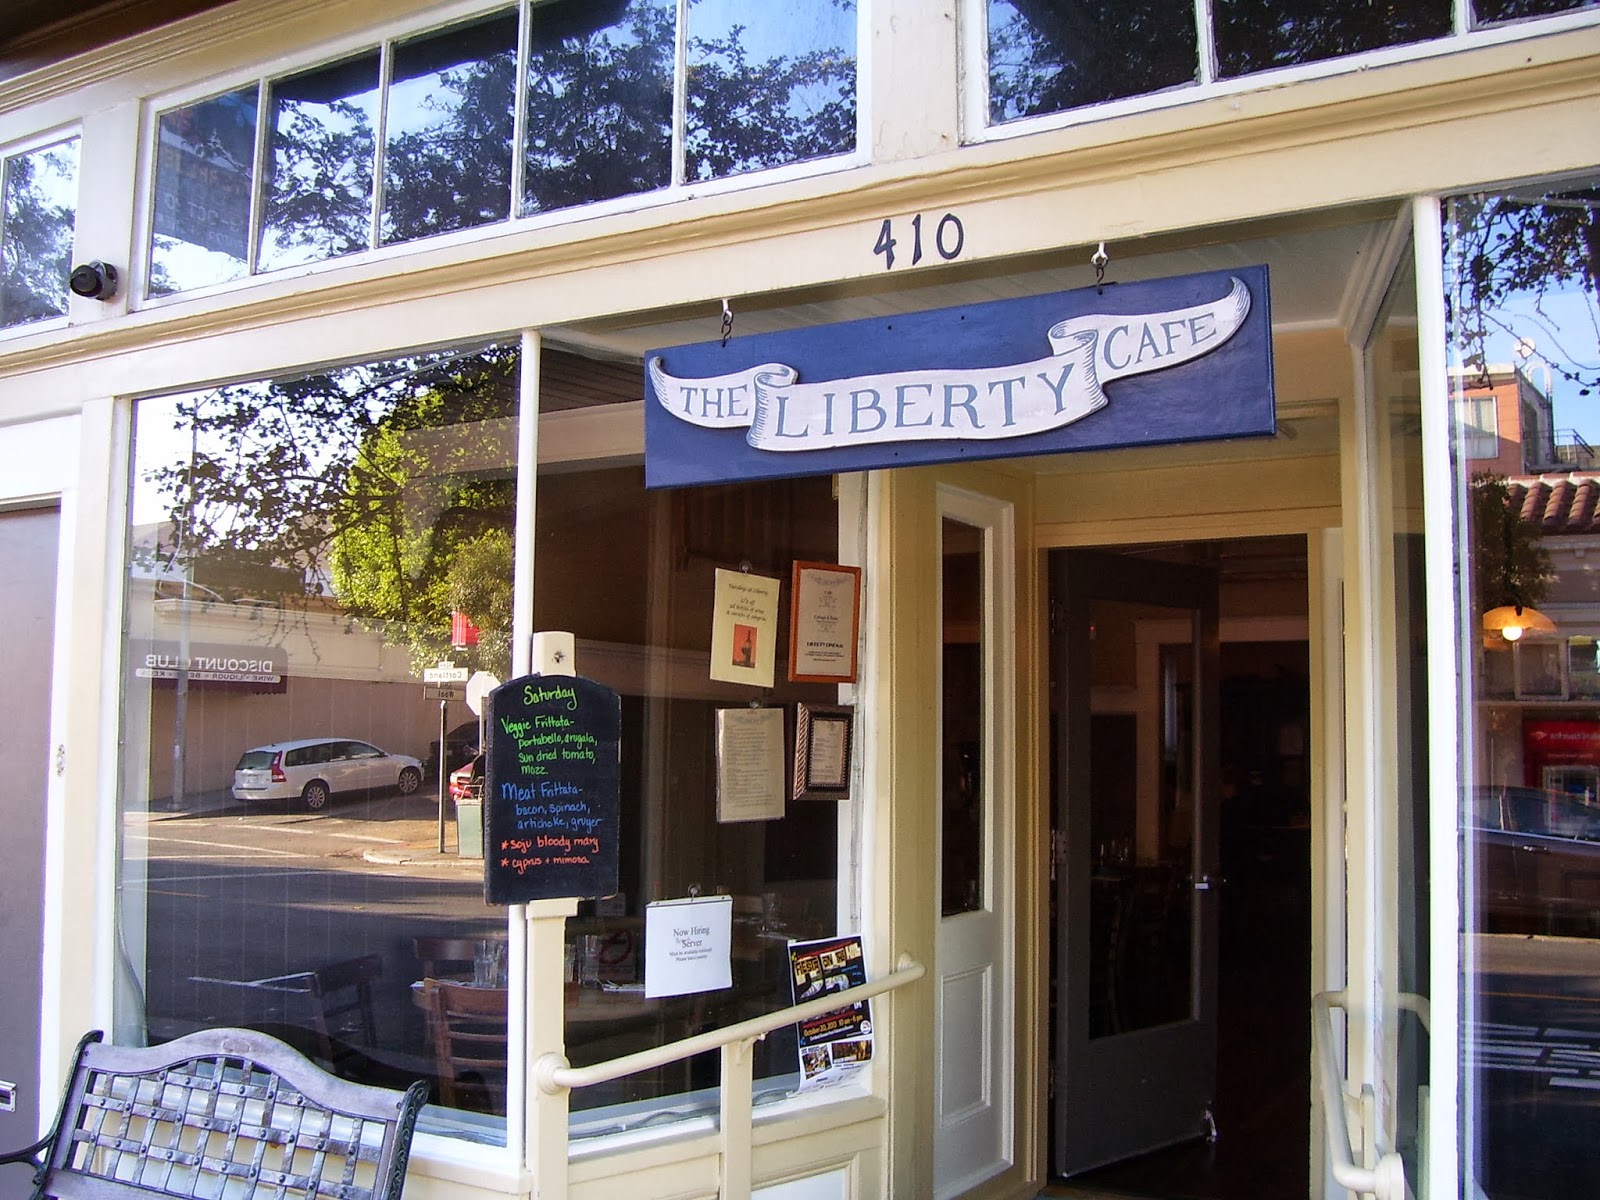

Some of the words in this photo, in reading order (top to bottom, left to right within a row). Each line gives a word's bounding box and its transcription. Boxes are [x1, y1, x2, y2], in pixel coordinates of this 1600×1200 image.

[873, 213, 964, 270] 410
[679, 383, 749, 419] THE
[774, 362, 1075, 438] LIBERTY
[1103, 311, 1218, 371] CAFE
[523, 685, 577, 711] Saturday
[500, 715, 531, 739] Veggie
[518, 752, 534, 763] sun
[536, 748, 557, 762] dried
[562, 747, 596, 765] tomato,
[501, 782, 536, 801] Meat
[515, 803, 547, 816] bacon,
[536, 834, 571, 852] bloody
[573, 836, 599, 853] mary
[673, 928, 689, 937] Now
[690, 926, 710, 936] Hiring
[681, 939, 703, 948] Server
[795, 957, 820, 976] FIESTA
